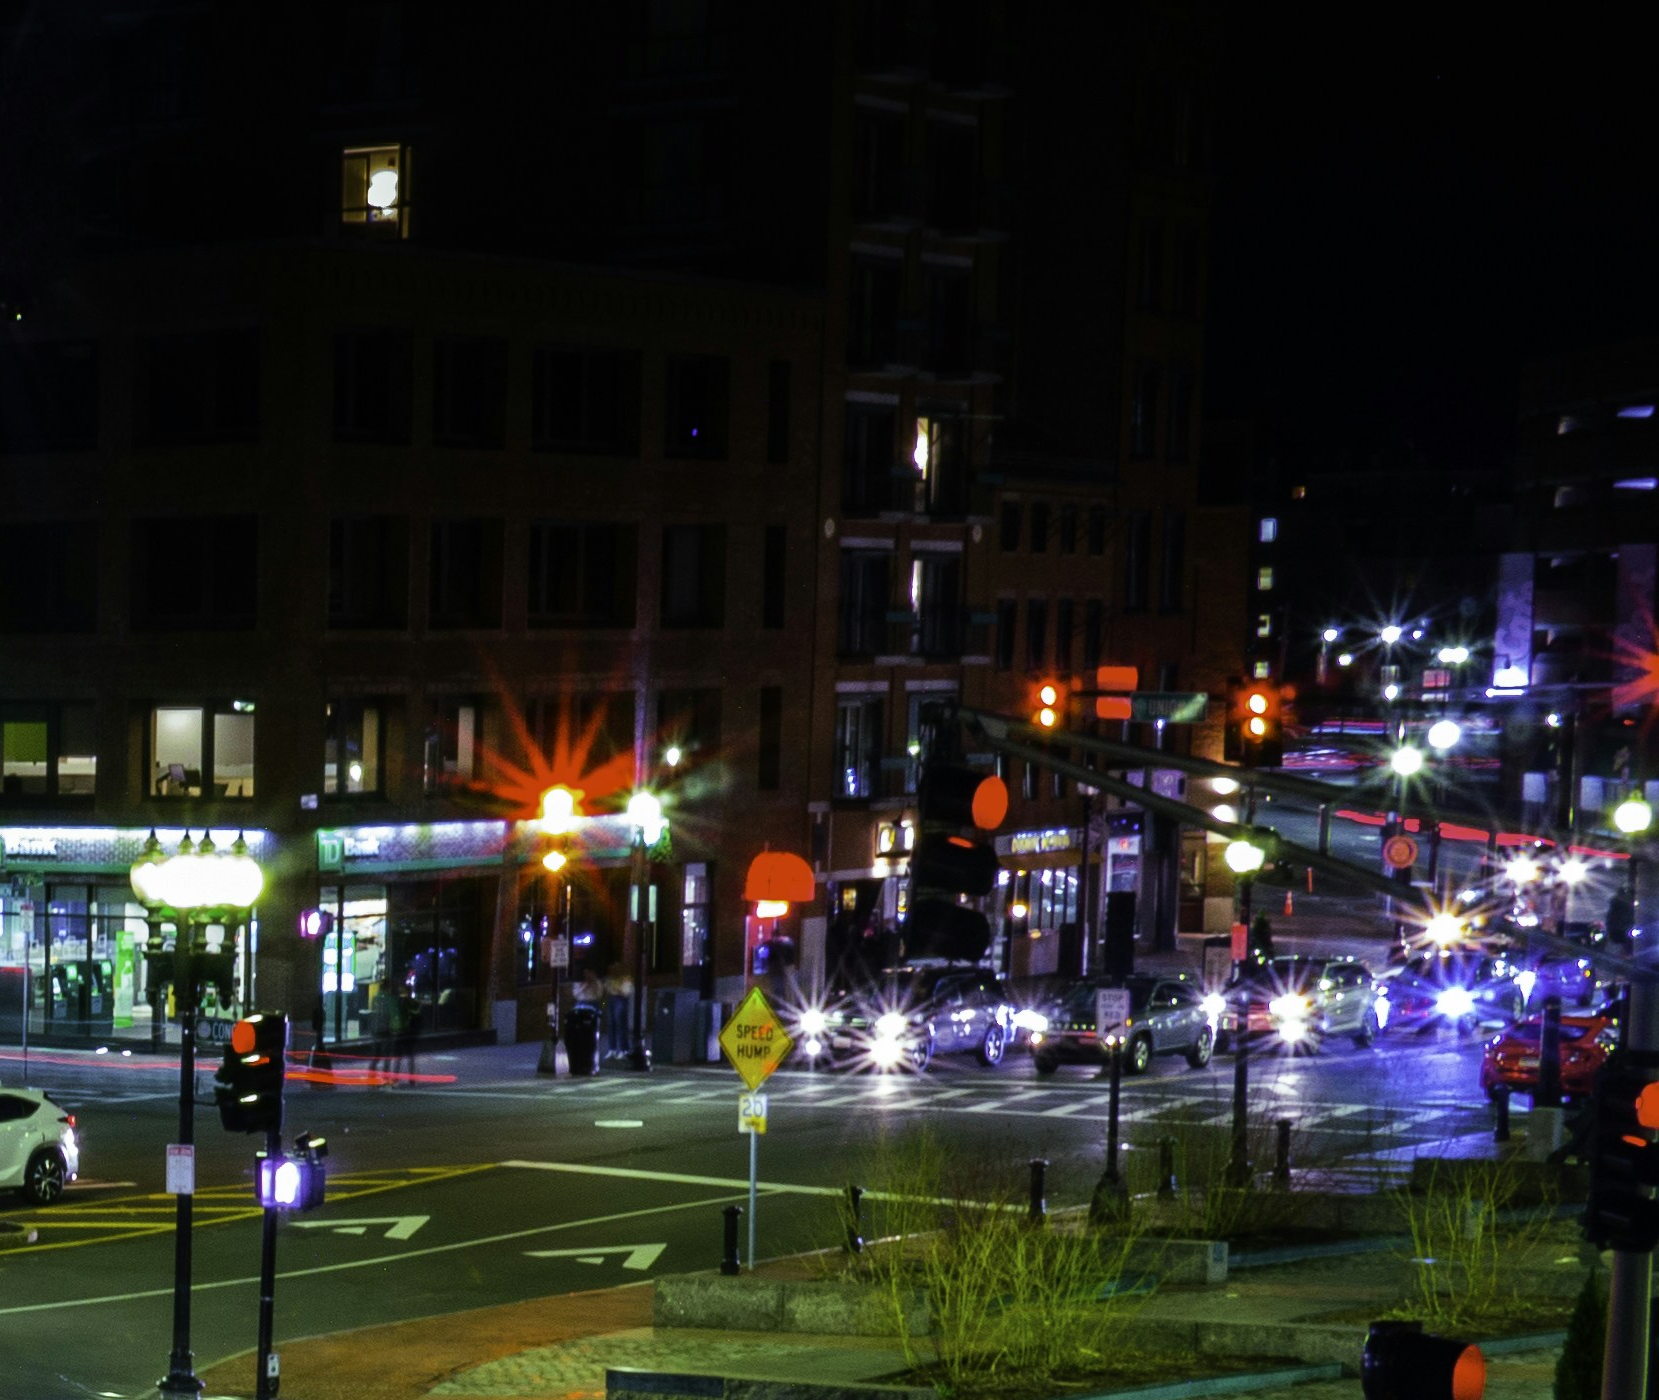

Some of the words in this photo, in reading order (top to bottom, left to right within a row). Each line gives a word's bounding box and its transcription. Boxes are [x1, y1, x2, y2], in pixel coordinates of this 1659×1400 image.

[736, 1023, 774, 1040] SPEED
[737, 1044, 771, 1058] HUMP
[743, 1100, 763, 1117] 20
